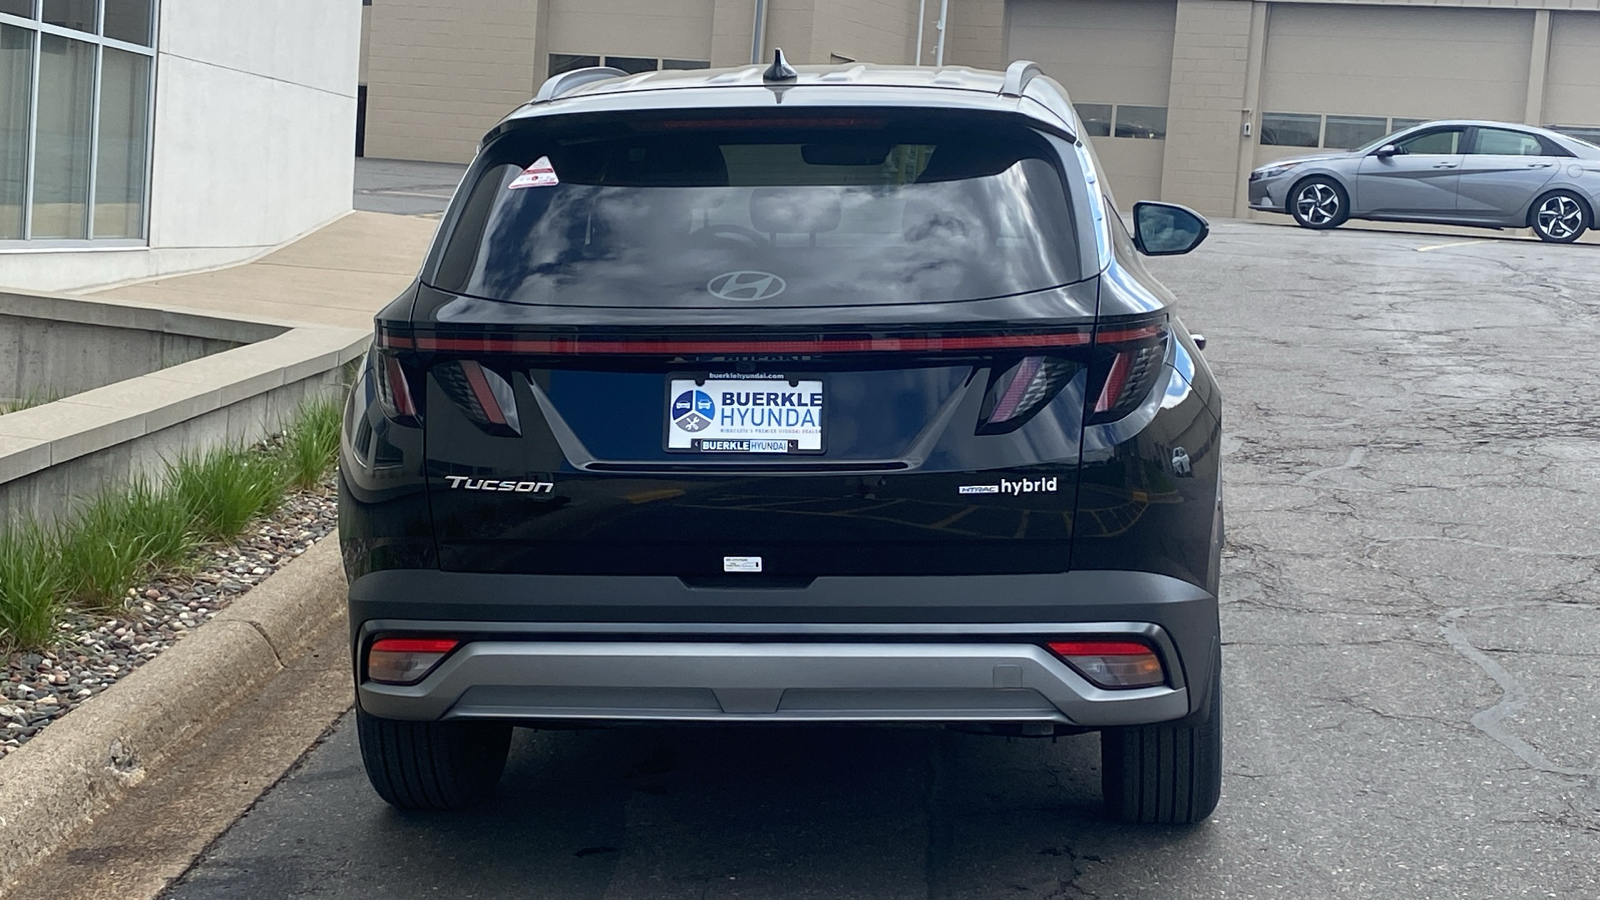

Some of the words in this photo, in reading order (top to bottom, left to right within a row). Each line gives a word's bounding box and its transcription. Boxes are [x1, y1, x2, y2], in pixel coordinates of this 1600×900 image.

[722, 392, 822, 406] BUERKLE
[720, 408, 822, 427] HYUNDAI
[702, 440, 750, 450] BUERKLE
[751, 441, 787, 450] HYUNDAI
[1001, 477, 1057, 496] hybrid
